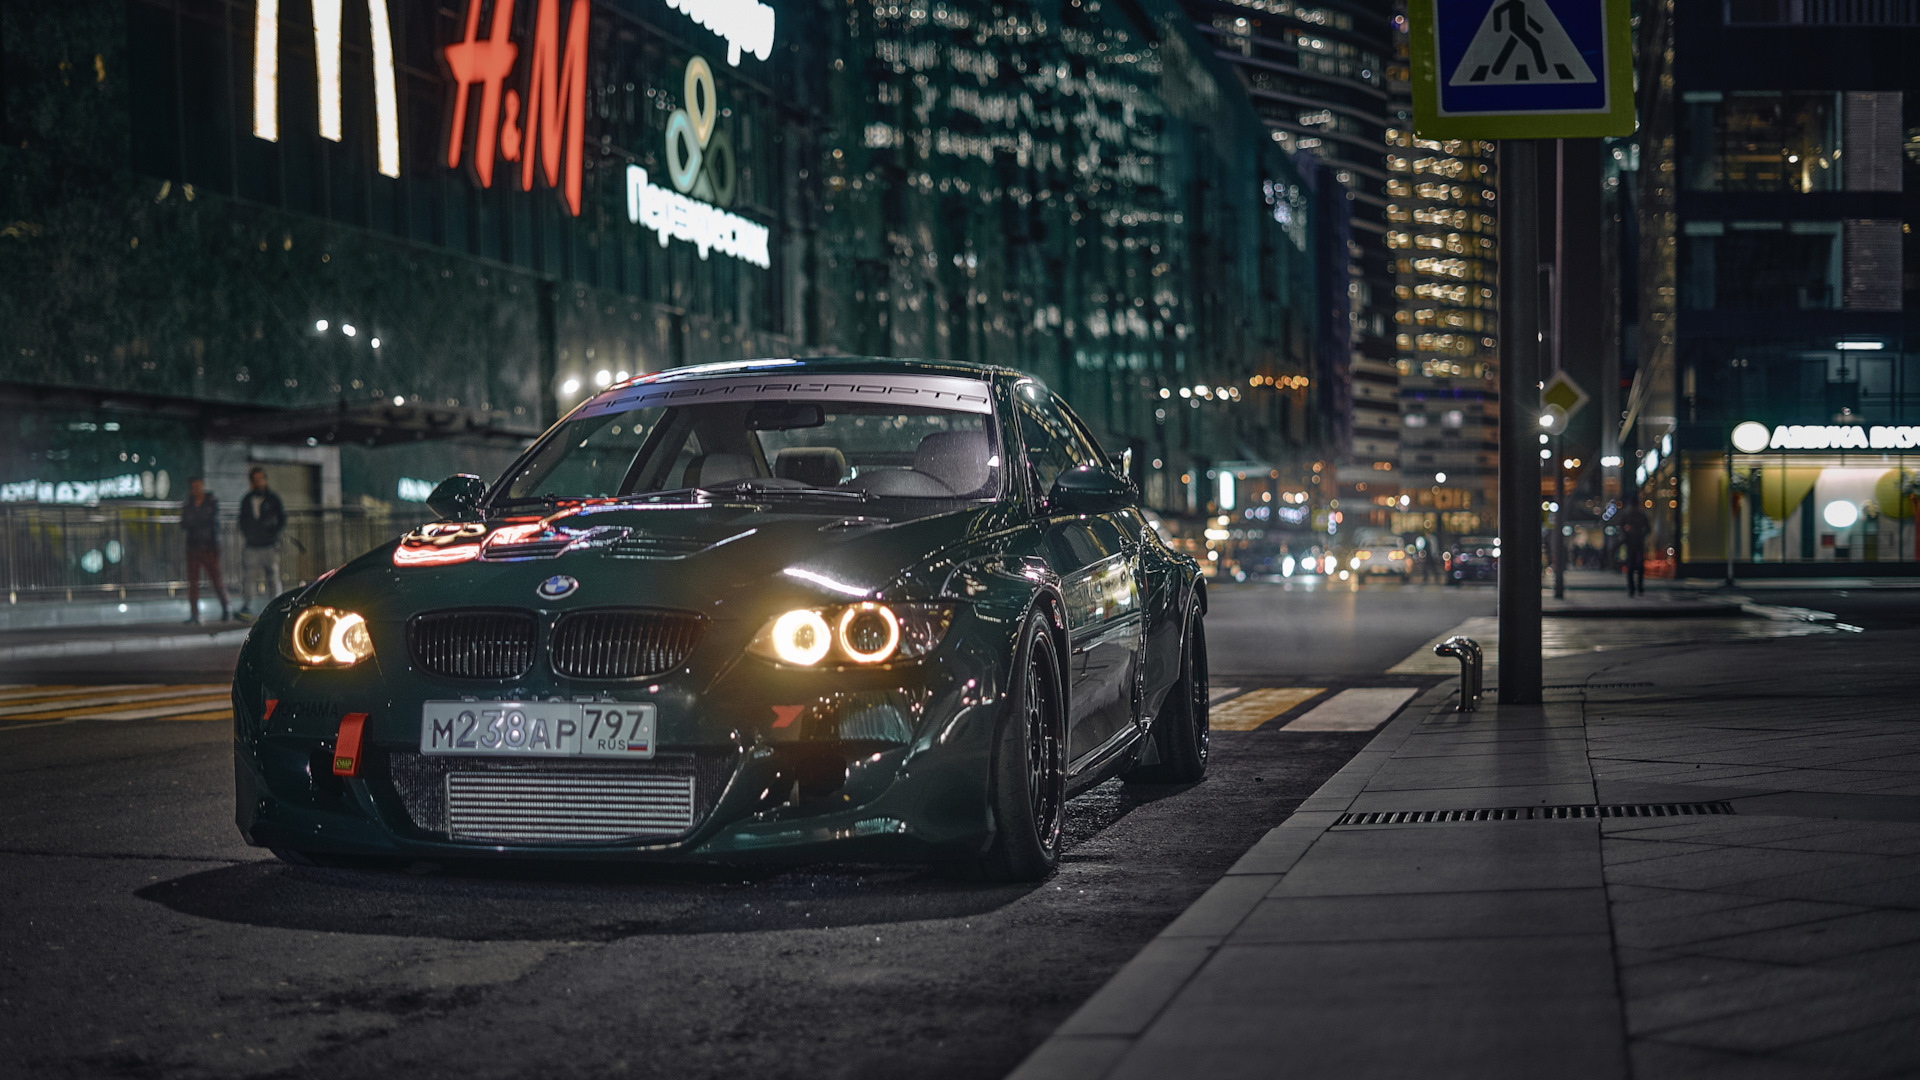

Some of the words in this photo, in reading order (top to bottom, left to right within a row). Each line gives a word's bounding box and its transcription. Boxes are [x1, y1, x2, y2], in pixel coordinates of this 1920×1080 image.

[443, 0, 590, 217] H&M
[1869, 426, 1920, 449] ВКУ
[585, 709, 645, 740] 797
[597, 738, 626, 751] RUS
